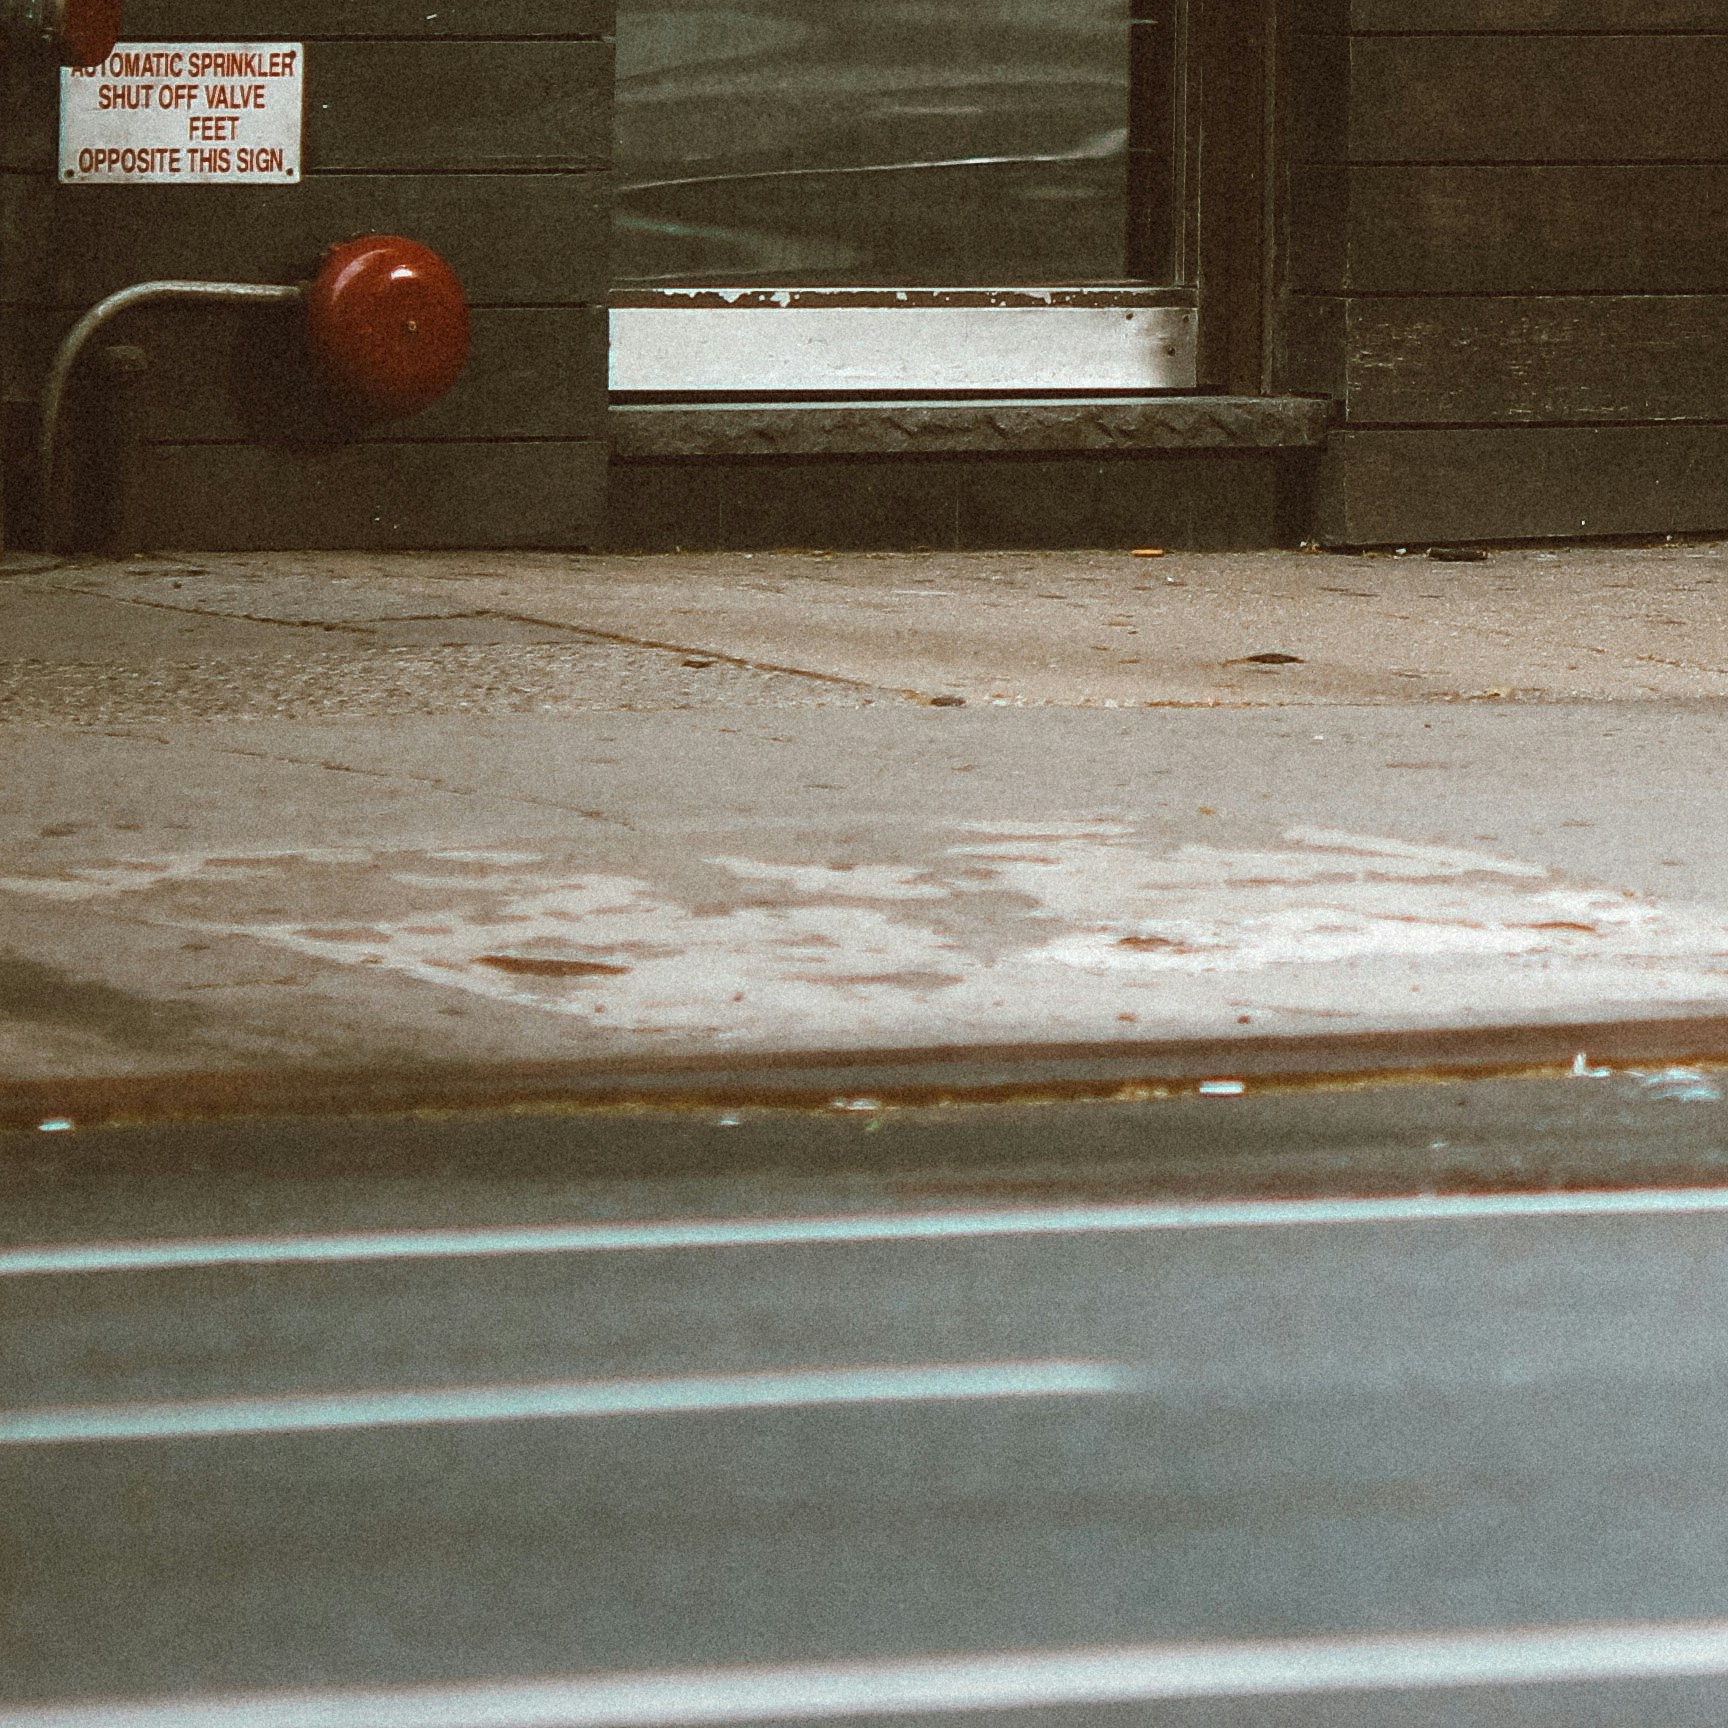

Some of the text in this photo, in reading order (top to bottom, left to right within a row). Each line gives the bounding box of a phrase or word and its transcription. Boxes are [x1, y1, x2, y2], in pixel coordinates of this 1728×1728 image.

[188, 53, 294, 78] SPRINKLER
[99, 84, 266, 110] SHUT OFF VALVE
[189, 116, 240, 141] FEET
[78, 148, 283, 174] OPPOSITE THIS SIGN
